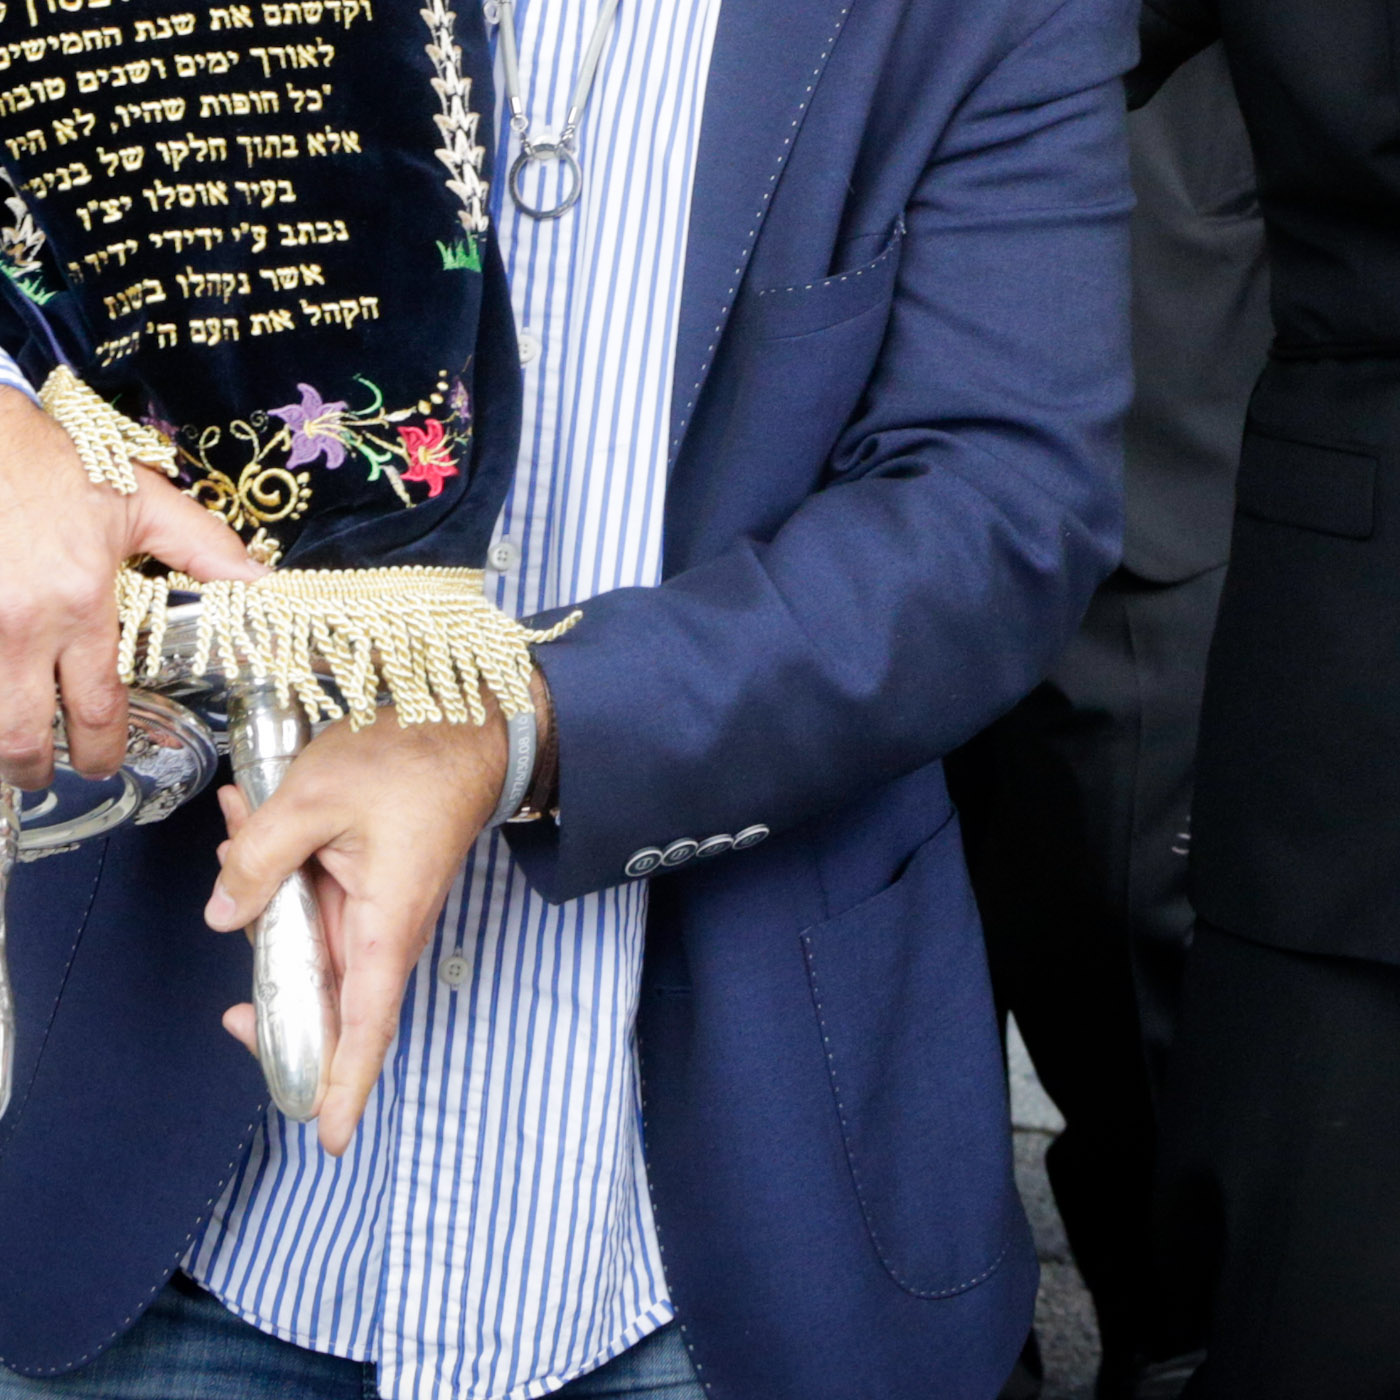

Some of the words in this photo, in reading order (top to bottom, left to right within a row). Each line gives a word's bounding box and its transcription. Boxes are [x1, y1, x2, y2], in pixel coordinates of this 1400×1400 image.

[134, 13, 195, 42] שנת
[209, 4, 253, 31] את
[174, 50, 239, 77] ימים
[249, 37, 335, 78] לאורך
[76, 57, 167, 93] ושנים
[110, 97, 186, 134] שהיו,
[199, 90, 279, 118] חופות
[52, 107, 96, 145] לא
[307, 124, 362, 157] אלא
[4, 129, 47, 160] היו
[155, 132, 227, 172] חלקו
[236, 134, 299, 168] בתוך
[96, 145, 145, 177] של
[142, 178, 229, 212] אוסלו
[234, 179, 297, 209] בעיר
[149, 227, 223, 254] ידידי
[278, 220, 349, 247] נכתב
[175, 265, 251, 304] נקהלו
[259, 263, 325, 292] אשר
[249, 308, 295, 336] את
[299, 296, 379, 330] הקהל
[189, 317, 240, 347] העם
